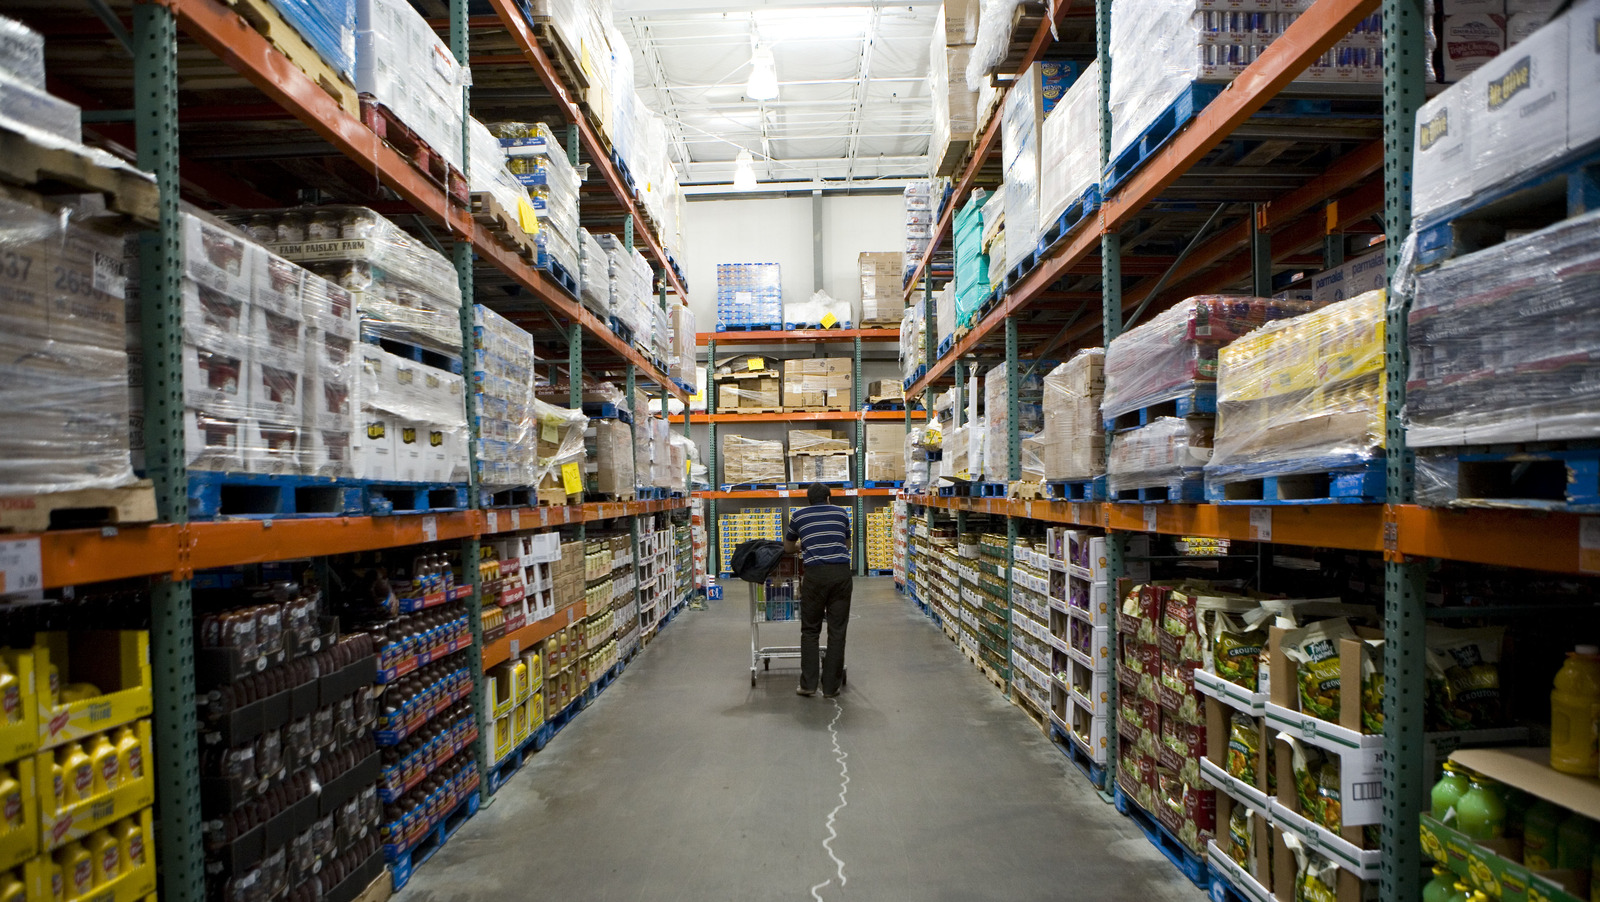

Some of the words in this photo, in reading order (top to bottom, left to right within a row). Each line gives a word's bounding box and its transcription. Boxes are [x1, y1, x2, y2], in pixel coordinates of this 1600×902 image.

[279, 245, 302, 254] FARM
[306, 243, 338, 253] PAISLEY
[342, 241, 365, 250] FARM
[1351, 252, 1385, 277] parmalat
[1316, 268, 1344, 291] parmalat
[1230, 646, 1261, 657] CROUTON
